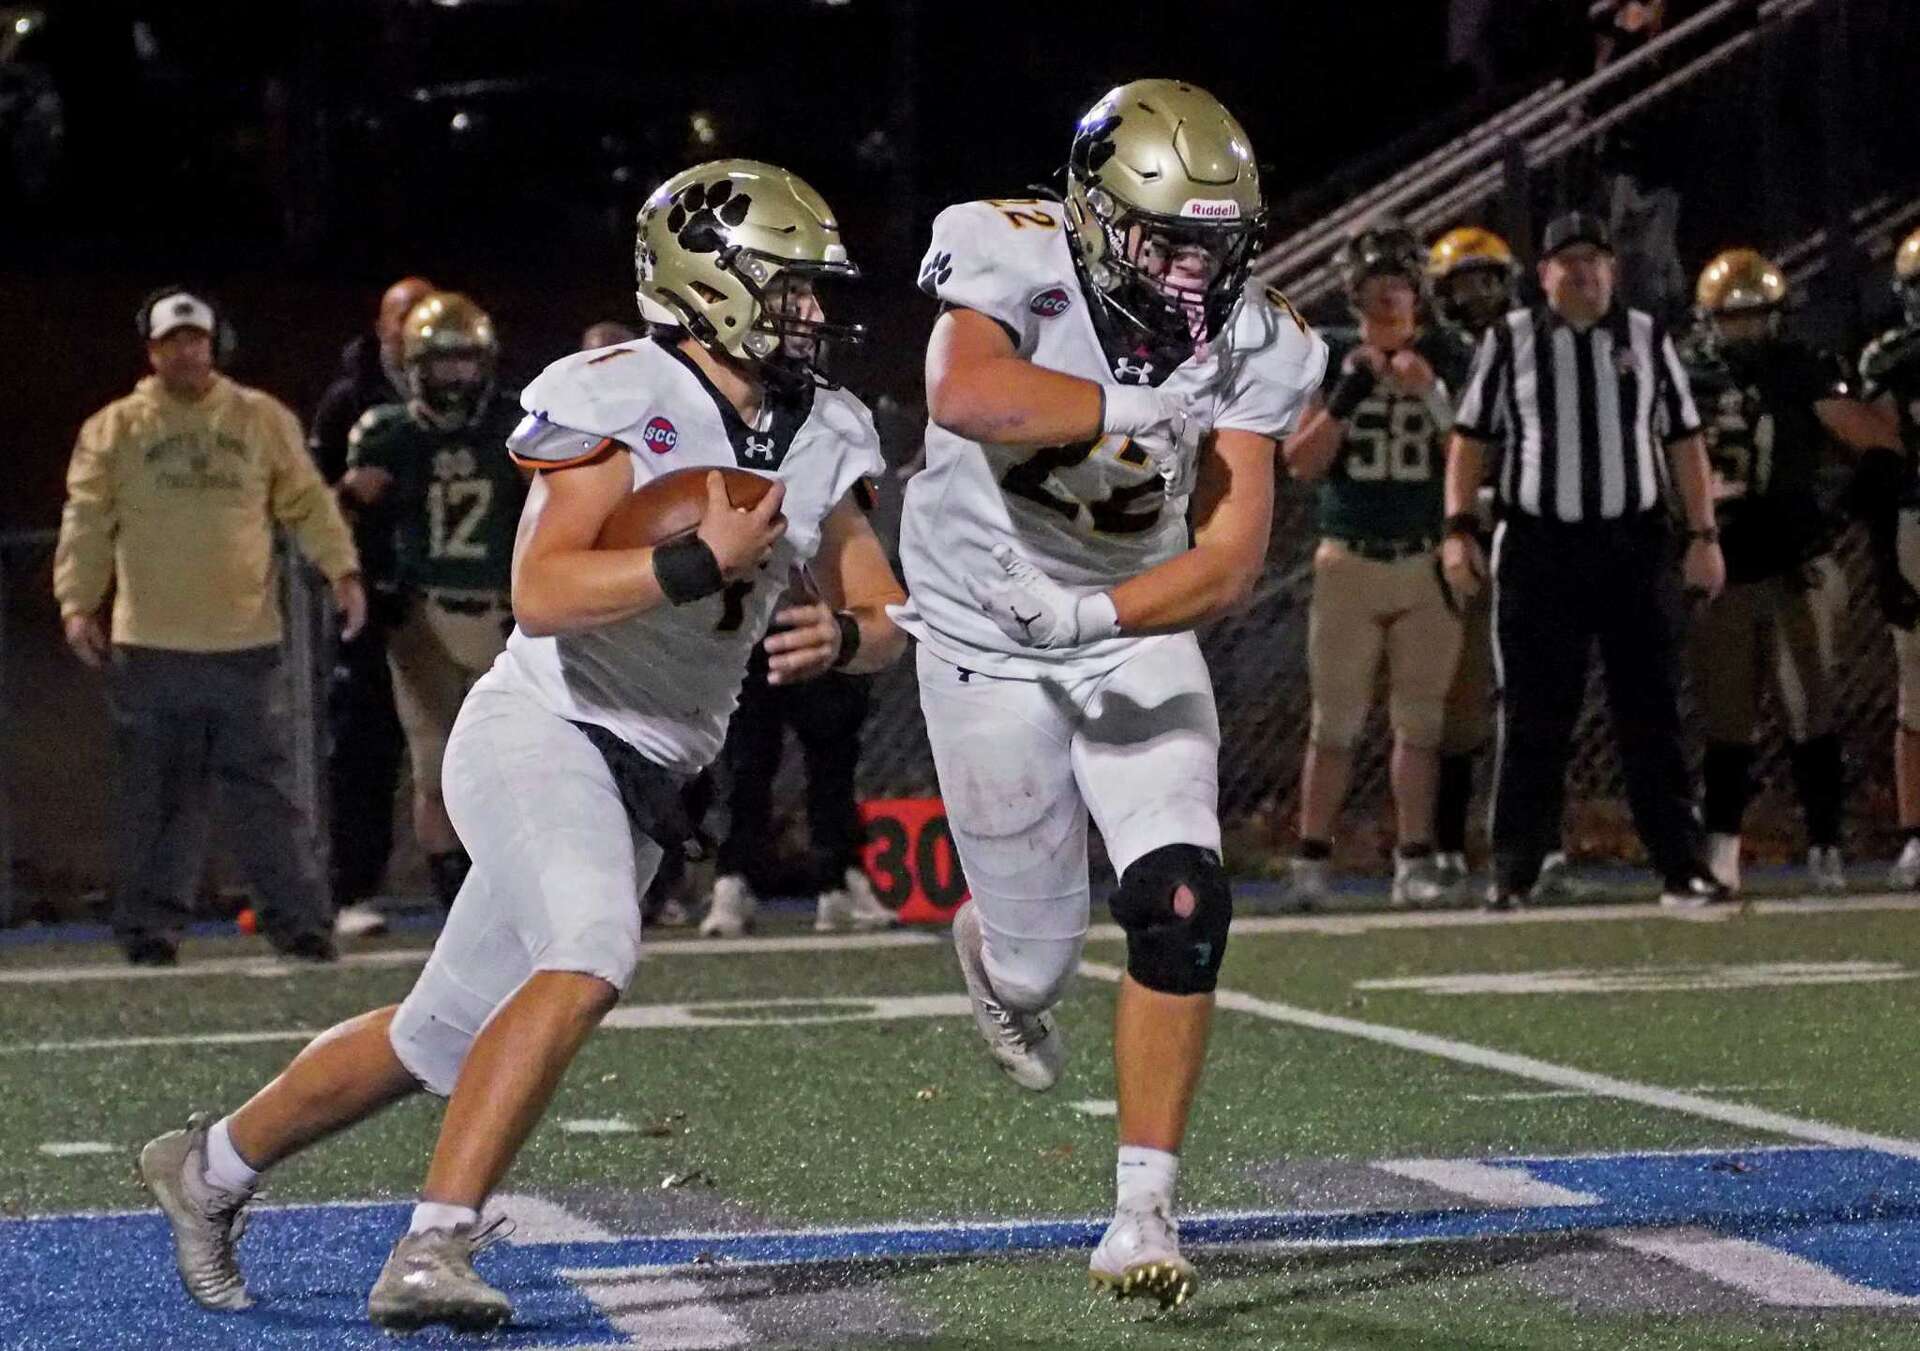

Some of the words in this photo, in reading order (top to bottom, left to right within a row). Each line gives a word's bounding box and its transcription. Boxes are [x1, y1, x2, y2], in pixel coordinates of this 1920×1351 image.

[1192, 203, 1236, 216] Riddell
[644, 426, 677, 446] SCC
[1347, 399, 1431, 481] 58
[427, 479, 493, 559] 12
[860, 815, 968, 908] 30
